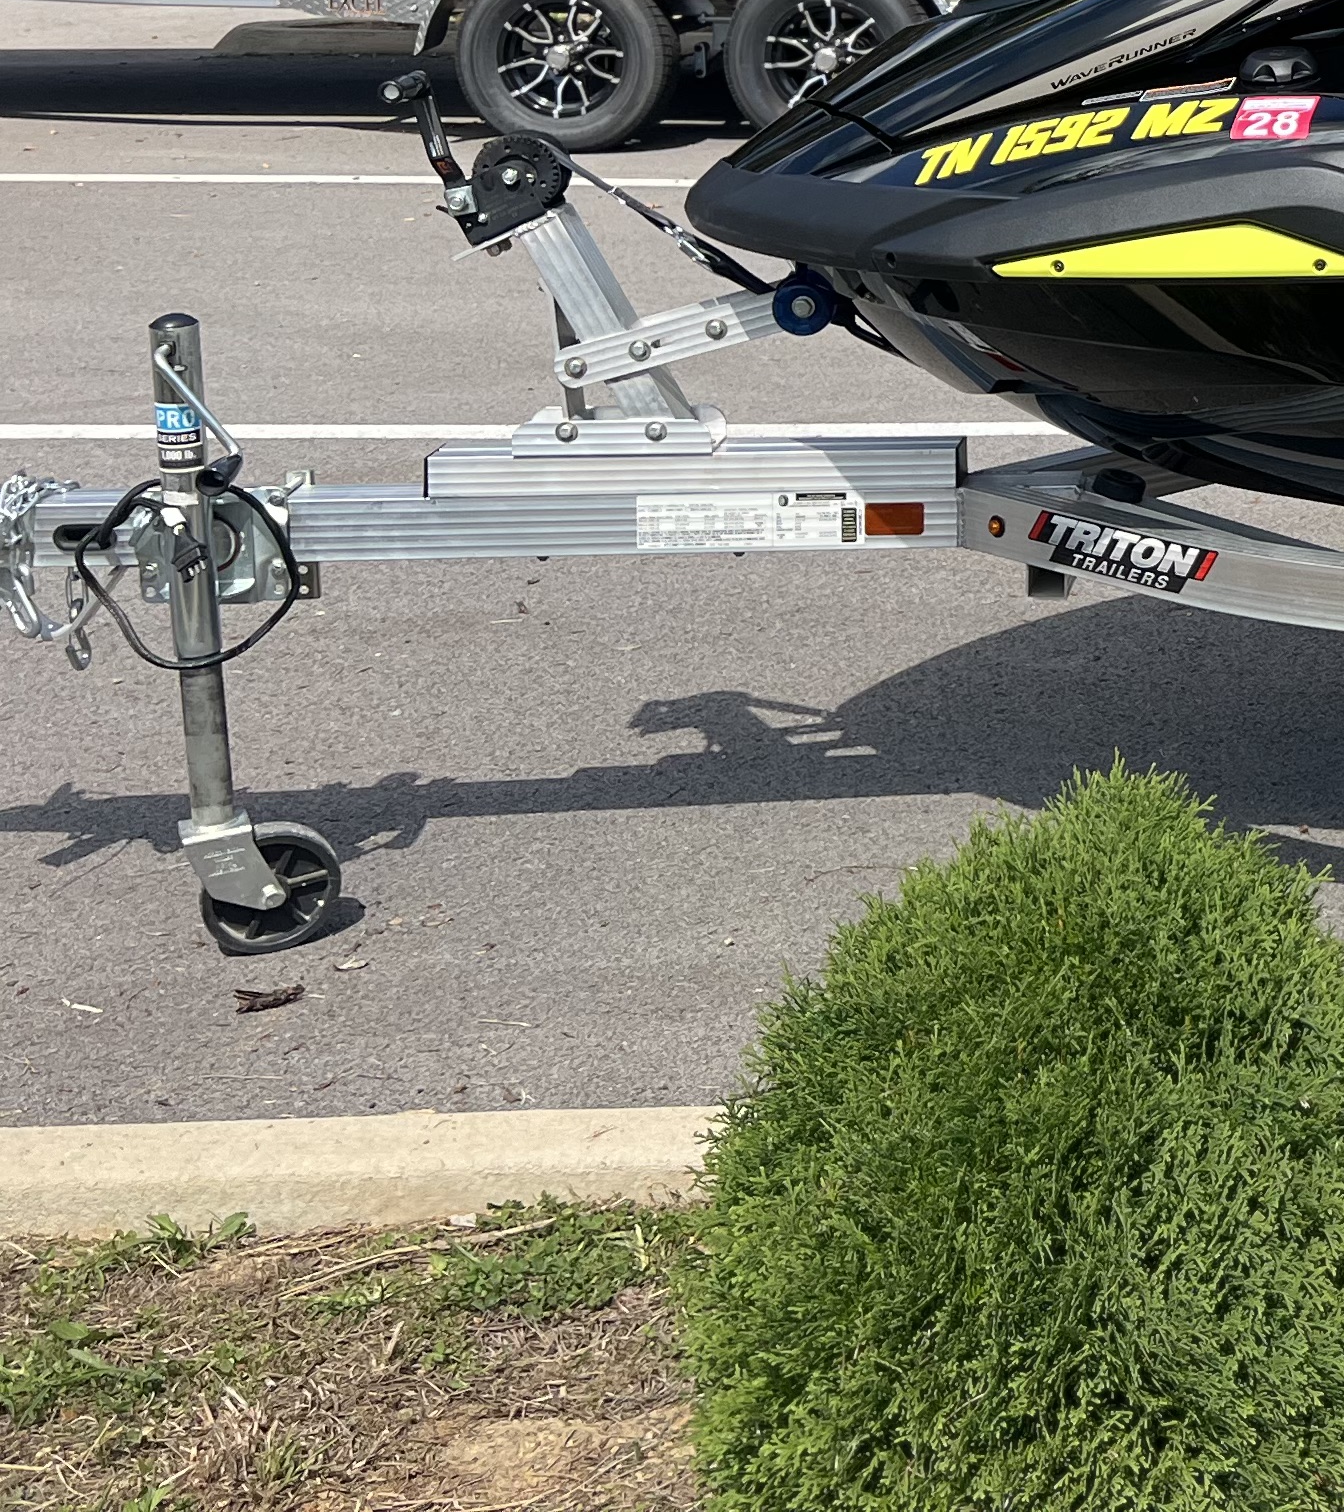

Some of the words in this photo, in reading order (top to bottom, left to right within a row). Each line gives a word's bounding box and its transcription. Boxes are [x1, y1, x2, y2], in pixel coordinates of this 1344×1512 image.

[914, 132, 993, 186] TN
[991, 106, 1131, 166] 1592
[1131, 97, 1240, 140] MZ
[1242, 111, 1300, 137] 28
[156, 409, 196, 429] PRO
[1049, 514, 1201, 577] TRITON
[1071, 553, 1171, 589] TRAILERS
